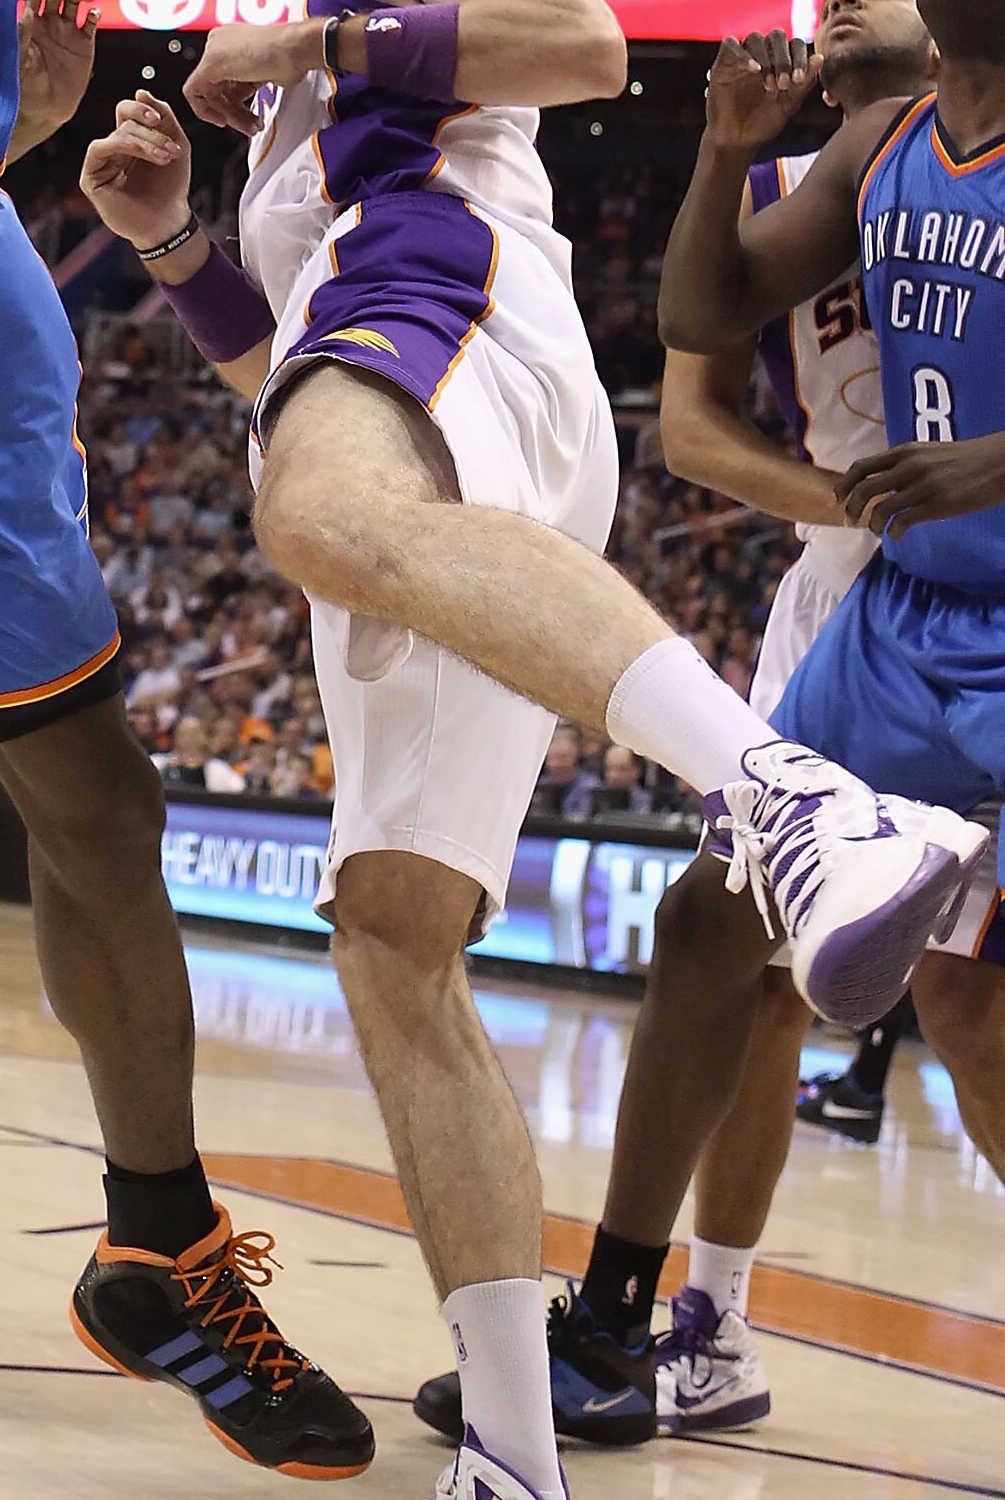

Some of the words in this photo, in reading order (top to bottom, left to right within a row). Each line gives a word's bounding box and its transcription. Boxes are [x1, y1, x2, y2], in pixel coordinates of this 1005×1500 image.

[890, 277, 972, 339] CITY
[912, 366, 955, 442] 8
[161, 830, 257, 891] HEAVY
